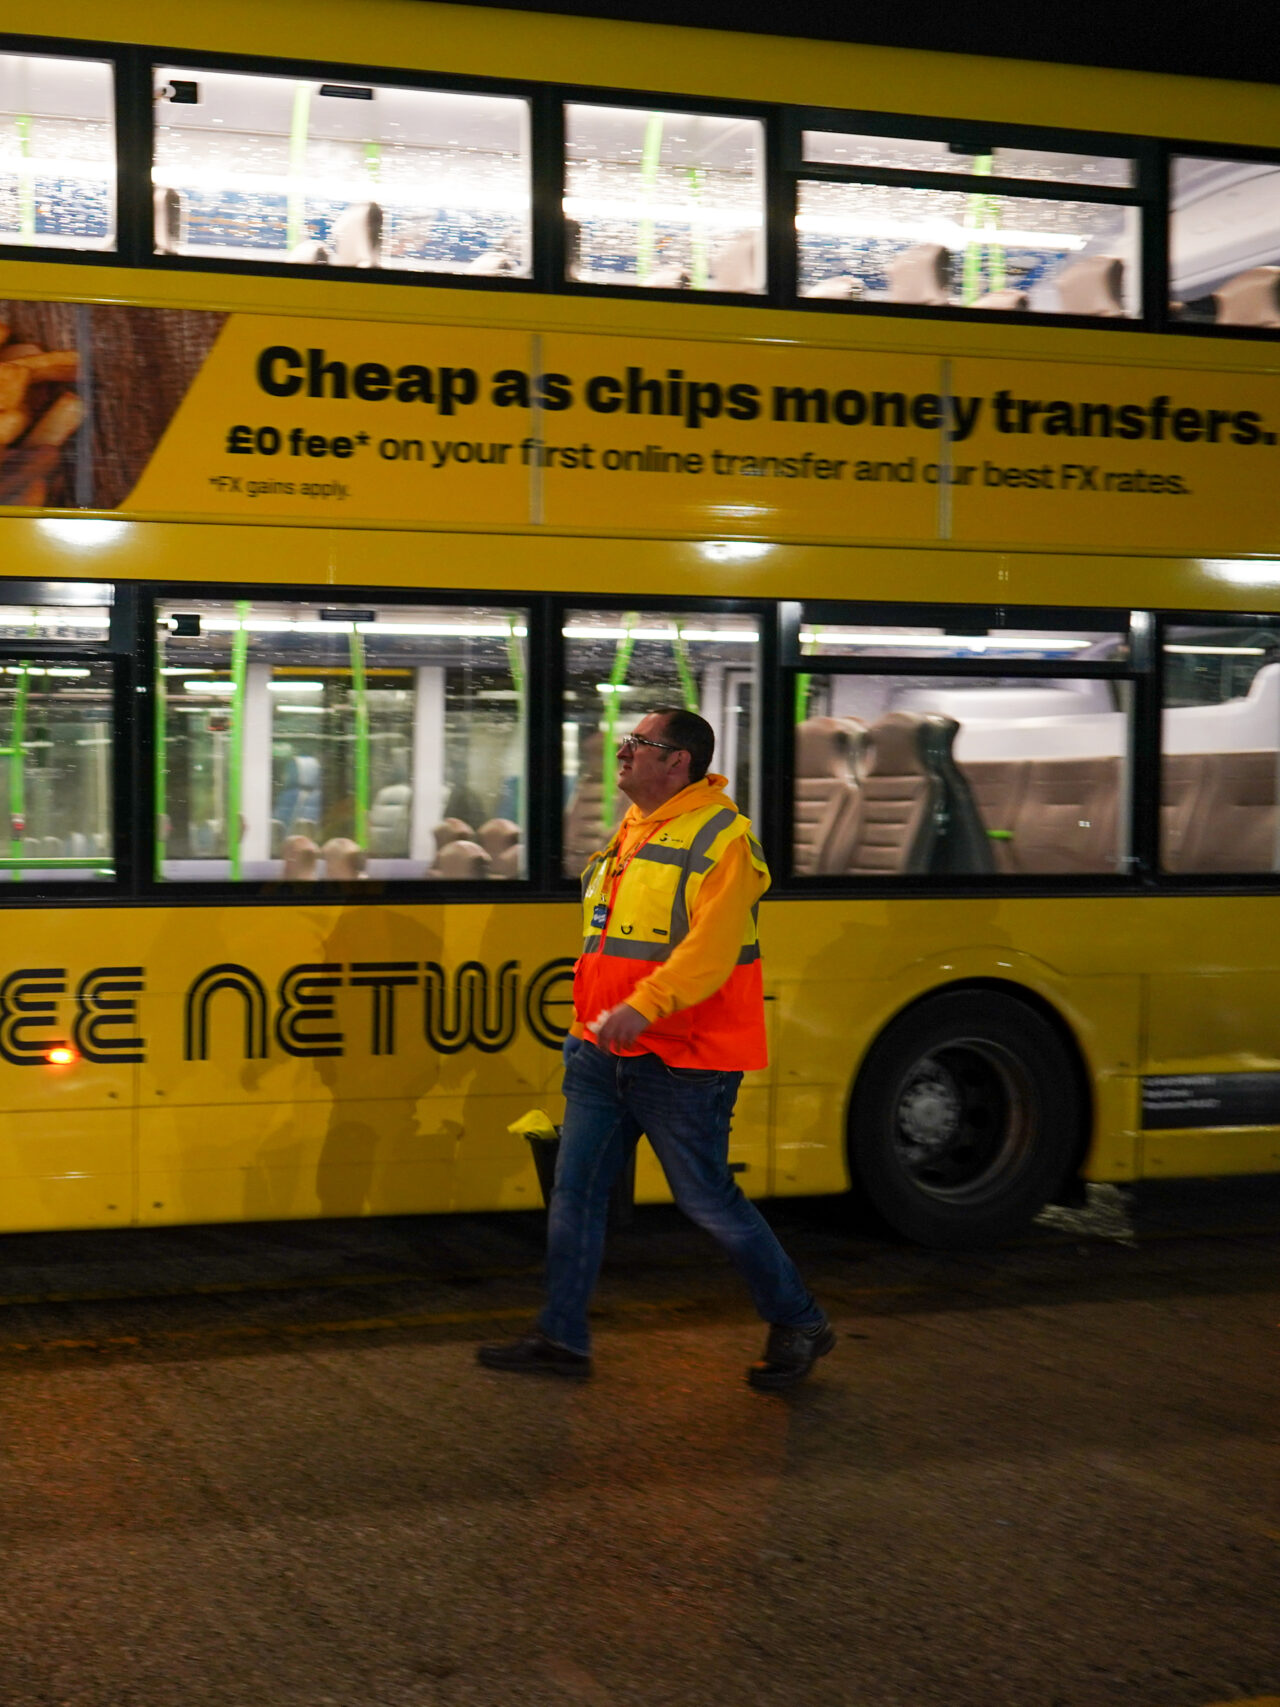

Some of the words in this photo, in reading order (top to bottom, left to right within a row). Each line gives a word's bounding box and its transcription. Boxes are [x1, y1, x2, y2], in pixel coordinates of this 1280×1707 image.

[256, 345, 480, 416] Cheap
[490, 367, 575, 412] as
[584, 366, 761, 429] chips
[771, 384, 984, 442] money
[992, 389, 1278, 447] transfers.
[226, 425, 281, 455] £0
[379, 436, 424, 462] on
[431, 438, 512, 468] your
[523, 438, 596, 470] first
[601, 445, 704, 476] online
[711, 448, 848, 481] transfer
[854, 457, 915, 484] and
[924, 462, 972, 487] our
[983, 461, 1054, 490] best
[1061, 464, 1100, 492] FX
[1104, 469, 1193, 495] rates.
[246, 477, 295, 499] gains
[300, 480, 351, 501] apply.
